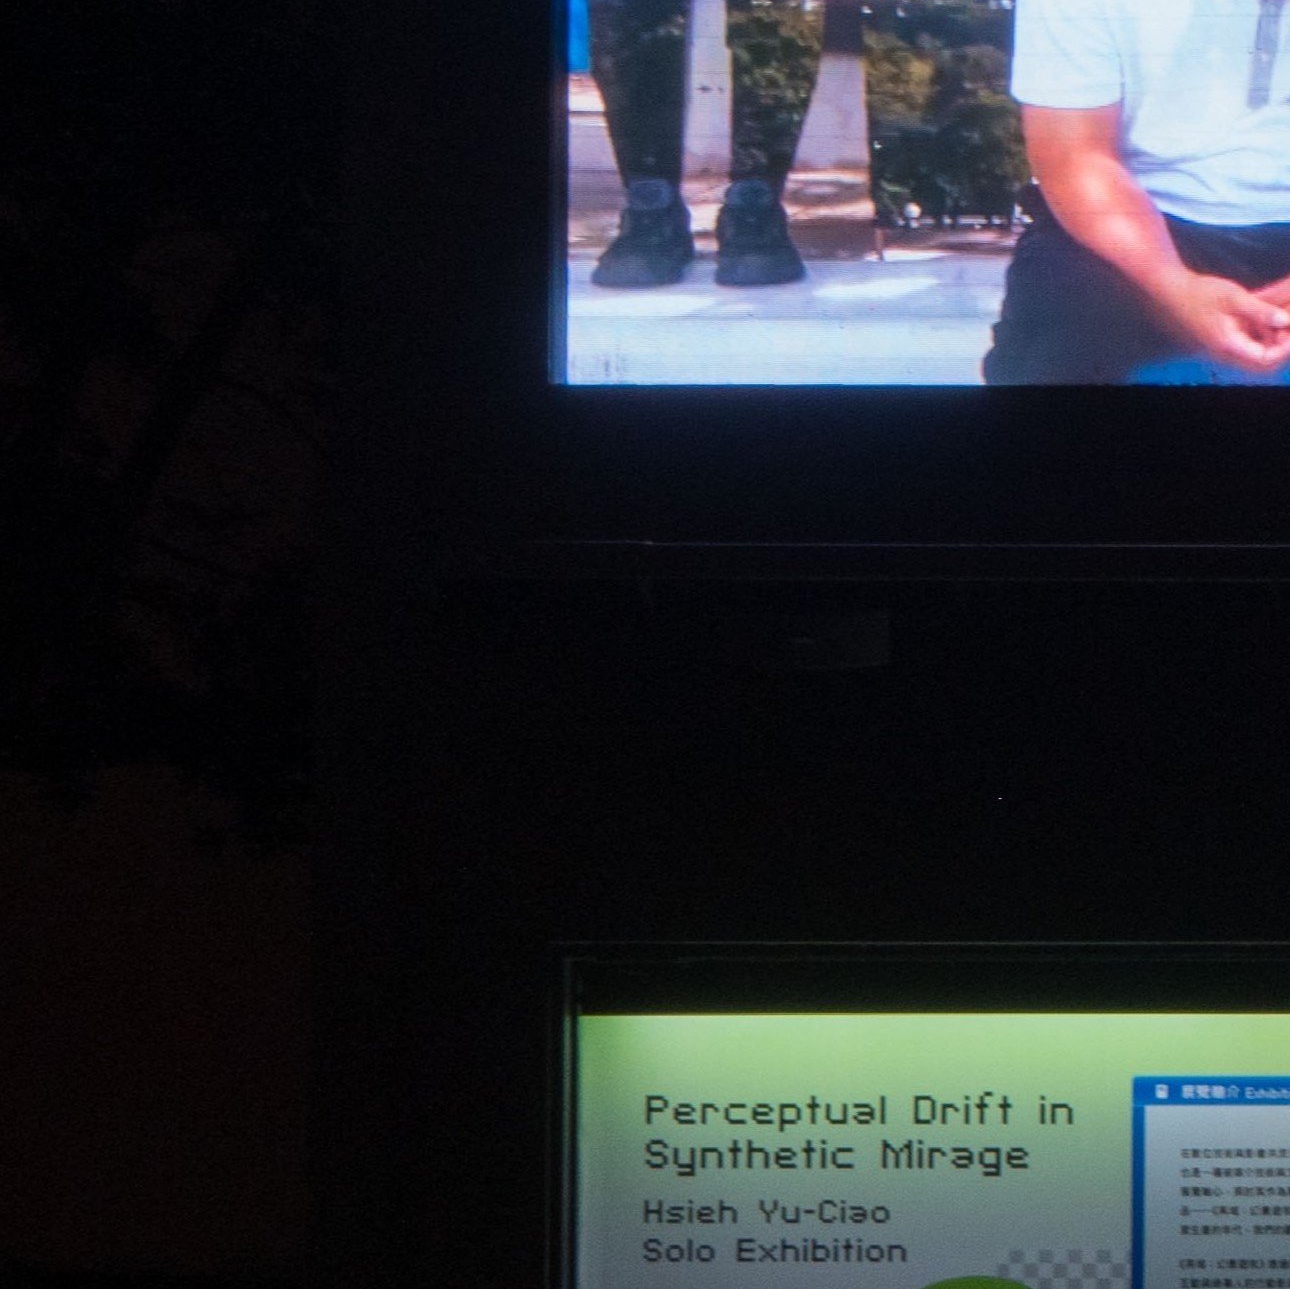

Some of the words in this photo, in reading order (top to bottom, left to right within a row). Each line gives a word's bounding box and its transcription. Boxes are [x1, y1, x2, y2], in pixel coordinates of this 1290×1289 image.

[645, 1095, 887, 1132] Perceptual
[913, 1095, 1012, 1125] Drift
[1039, 1095, 1073, 1125] in
[645, 1140, 855, 1176] Synthetic
[881, 1140, 1029, 1176] Mirage
[644, 1200, 738, 1224] Hsieh
[759, 1200, 890, 1224] Yu-Ciao
[643, 1239, 715, 1263] Solo
[736, 1238, 907, 1263] Exhibition
